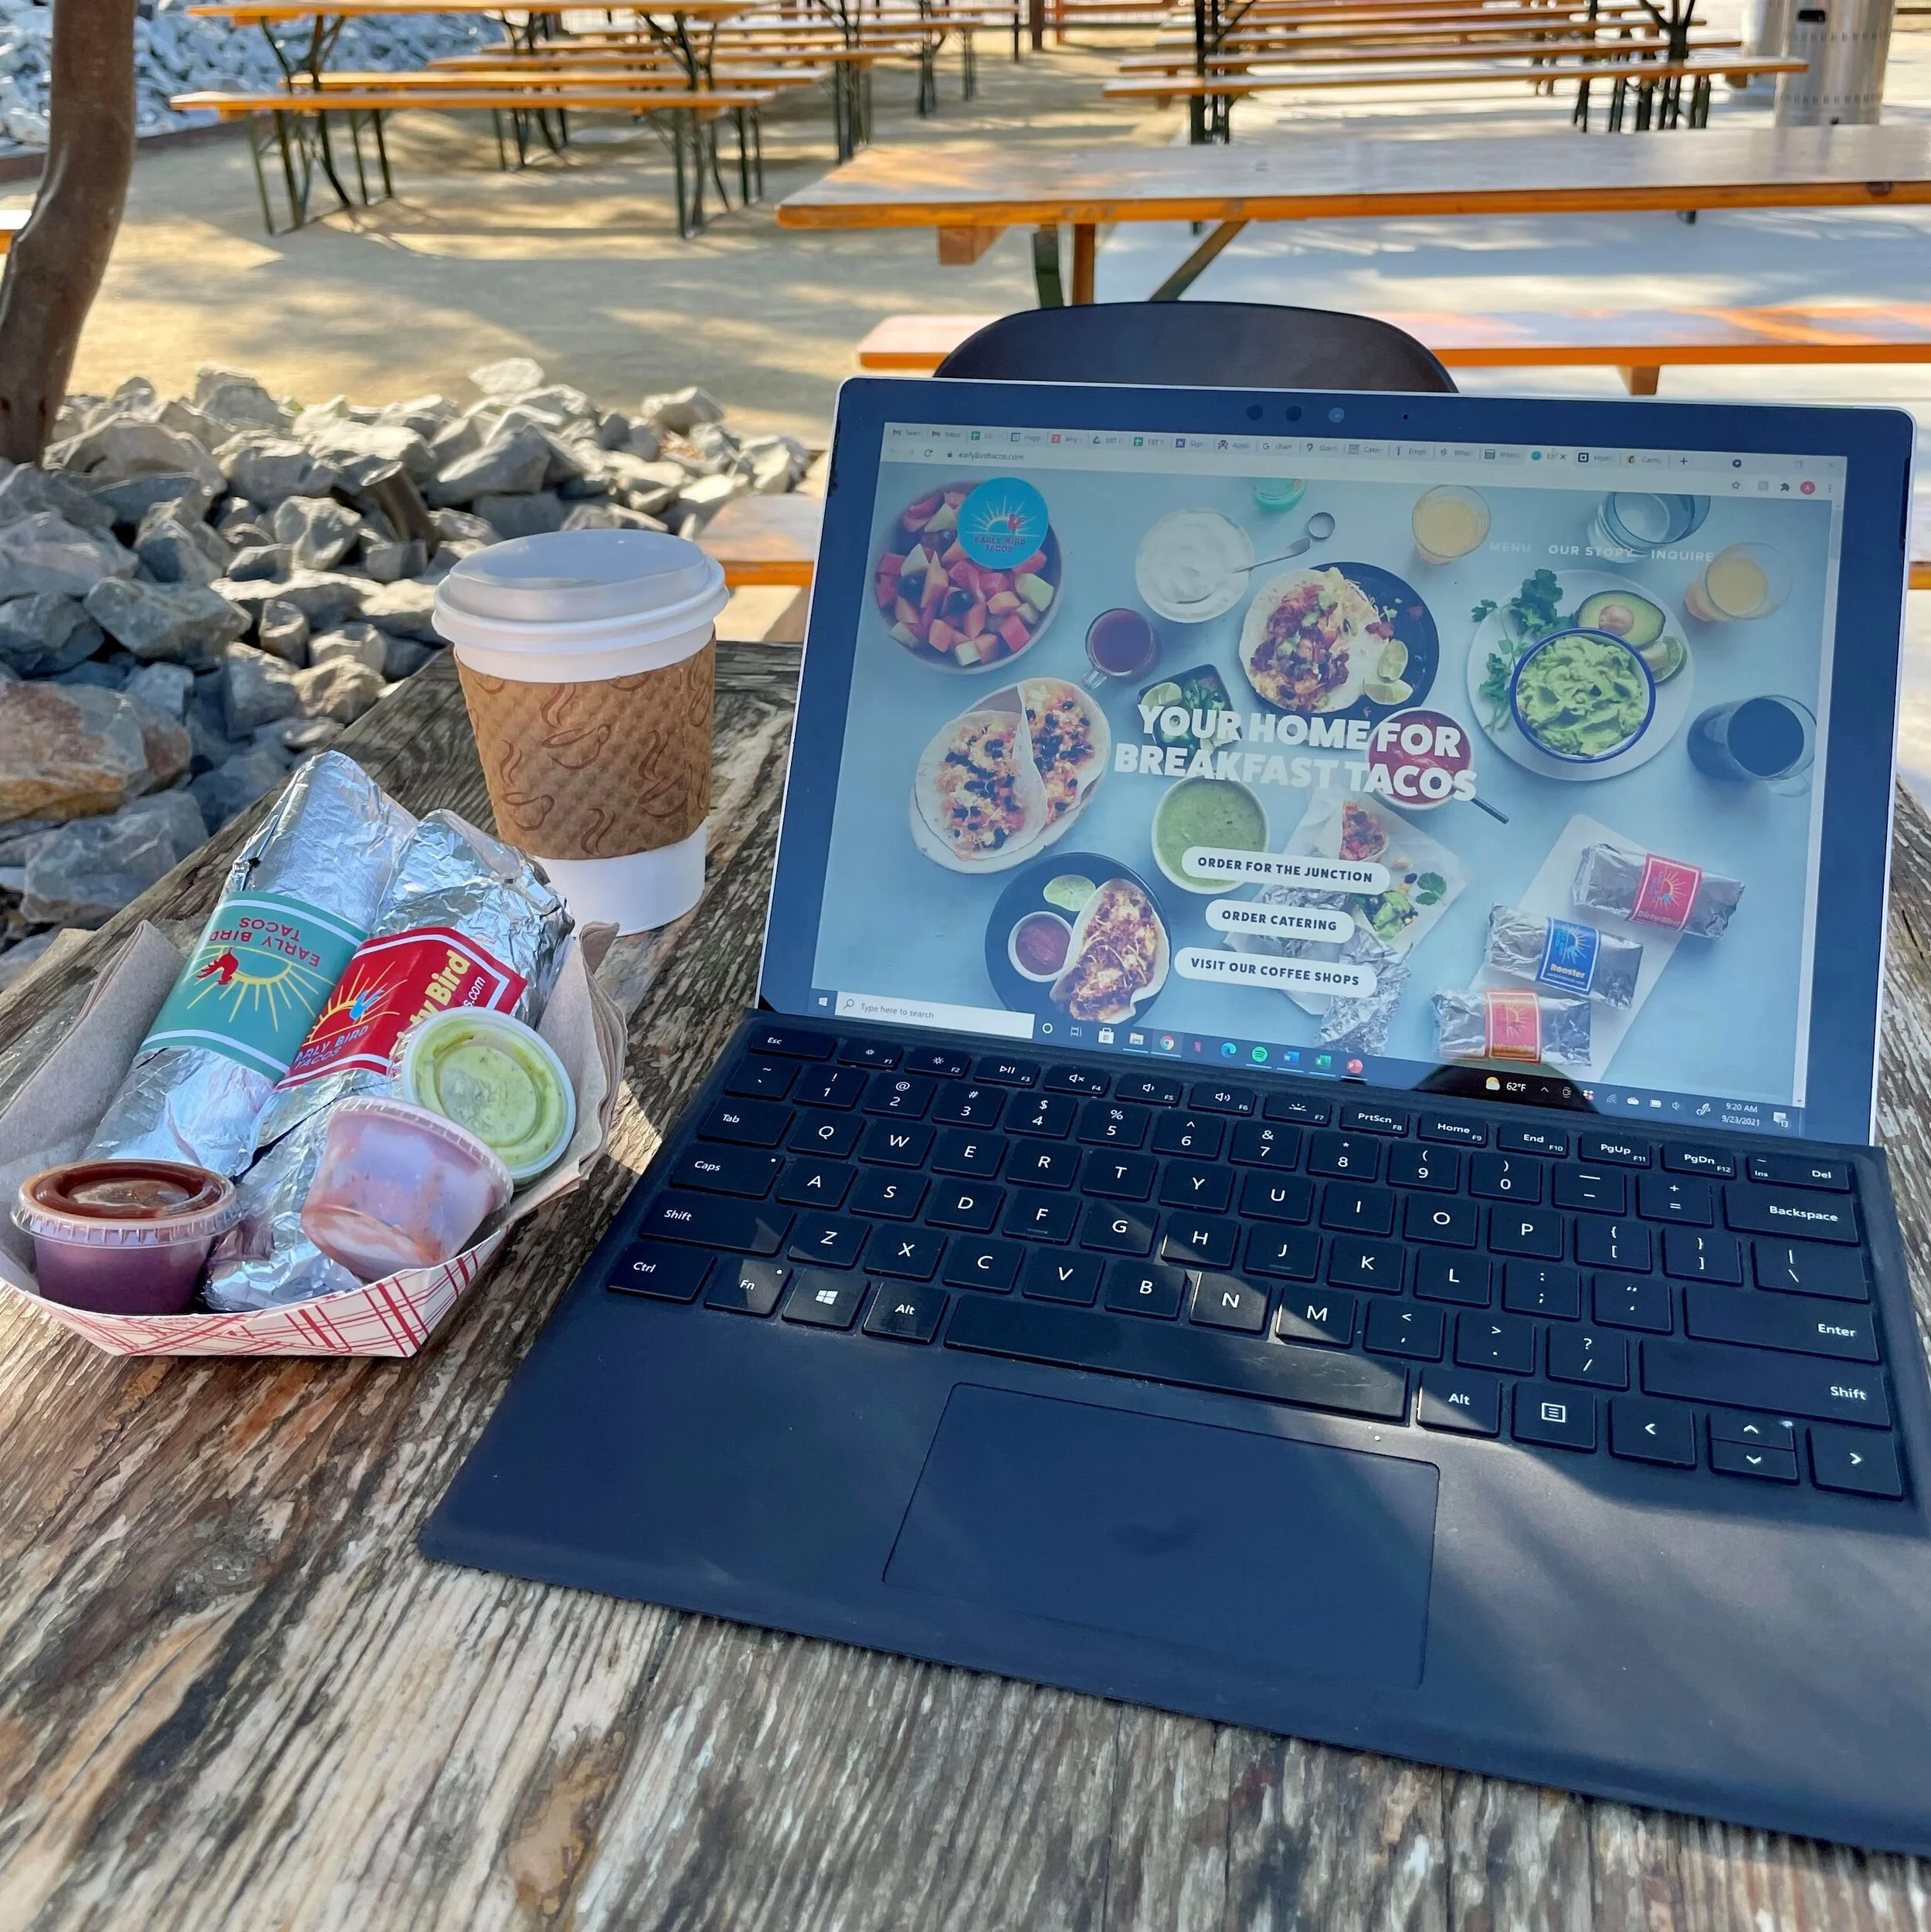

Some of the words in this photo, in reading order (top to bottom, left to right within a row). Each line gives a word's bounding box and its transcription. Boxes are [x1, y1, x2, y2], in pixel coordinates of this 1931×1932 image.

[958, 451, 1024, 462] earlybirdtacos.com
[974, 536, 1002, 545] EARLY
[985, 544, 1013, 552] TACOS
[1489, 542, 1531, 553] MENU
[1548, 545, 1580, 556] OUR
[1584, 546, 1634, 558] STORY
[1651, 549, 1714, 562] INQUIRE
[1138, 704, 1243, 742] YOUR
[1249, 713, 1370, 749] HOME
[1376, 722, 1461, 759] FOR
[1114, 742, 1339, 788] BREAKFAST
[1344, 761, 1477, 802] TACOS
[1197, 857, 1242, 871] ORDER
[1245, 861, 1272, 873] FOR
[1276, 864, 1301, 876] THE
[1304, 867, 1373, 883] JUNCTION
[1221, 909, 1267, 924] ORDER
[1270, 915, 1337, 932] CATERING
[209, 929, 253, 942] BIRD
[239, 917, 300, 942] TACOS
[261, 935, 321, 967] EARLY
[424, 949, 471, 1006] Bird
[1190, 957, 1226, 971] VISIT
[1229, 962, 1257, 975] OUR
[1260, 966, 1311, 981] COFFEE
[1314, 971, 1359, 986] SHOPS
[860, 1003, 878, 1014] Type
[880, 1004, 898, 1015] here
[899, 1007, 908, 1016] to
[909, 1009, 935, 1019] search
[334, 1025, 369, 1048] BIRD
[831, 1073, 838, 1082] !
[823, 1087, 831, 1097] 1
[895, 1081, 911, 1092] @
[1506, 1081, 1526, 1093] 62°F
[889, 1096, 901, 1107] 2
[1039, 1099, 1049, 1110] $
[1726, 1102, 1743, 1112] 9:20
[1743, 1105, 1758, 1113] AM
[960, 1105, 972, 1116] 3
[1110, 1109, 1124, 1120] %
[722, 1113, 740, 1123] Tab
[1032, 1115, 1043, 1126] 4
[1358, 1112, 1392, 1124] PrtScn
[1721, 1115, 1760, 1127] 9/23/2021
[1780, 1119, 1789, 1128] 13
[818, 1126, 835, 1140] Q
[1106, 1125, 1117, 1136] 5
[1261, 1129, 1274, 1140] &
[1437, 1122, 1471, 1134] Home
[890, 1134, 910, 1147] W
[1181, 1136, 1192, 1146] 6
[1523, 1133, 1544, 1143] End
[964, 1145, 977, 1158] E
[1260, 1146, 1271, 1157] 7
[1422, 1149, 1428, 1162] (
[1600, 1143, 1631, 1156] PgUp
[1037, 1156, 1051, 1169] R
[1337, 1156, 1349, 1167] 8
[1684, 1153, 1716, 1165] PgDn
[694, 1160, 721, 1172] Caps
[1115, 1166, 1128, 1179] T
[1503, 1160, 1509, 1172] )
[1418, 1167, 1429, 1179] 9
[1811, 1170, 1831, 1179] Del
[806, 1175, 821, 1188] A
[1192, 1177, 1206, 1190] Y
[1500, 1178, 1512, 1190] 0
[883, 1186, 897, 1198] S
[1271, 1188, 1286, 1202] U
[957, 1197, 974, 1210] D
[1356, 1200, 1362, 1213] I
[663, 1209, 692, 1221] Shift
[1036, 1208, 1049, 1221] F
[1433, 1211, 1451, 1225] O
[1769, 1205, 1838, 1222] Backspace
[1111, 1220, 1128, 1233] G
[1521, 1223, 1534, 1236] P
[1610, 1226, 1617, 1239] {
[820, 1231, 838, 1245] Z
[1192, 1231, 1209, 1245] H
[1697, 1237, 1704, 1250] }
[898, 1242, 915, 1258] X
[1278, 1244, 1288, 1258] J
[1611, 1245, 1617, 1258] [
[633, 1261, 657, 1273] Ctrl
[977, 1255, 993, 1269] C
[1361, 1255, 1375, 1271] K
[1699, 1256, 1705, 1270] ]
[1058, 1266, 1074, 1281] V
[1448, 1268, 1460, 1283] L
[739, 1279, 755, 1290] Fn
[1139, 1280, 1153, 1295] B
[1221, 1292, 1240, 1309] N
[894, 1304, 915, 1315] Alt
[1305, 1305, 1329, 1323] M
[1817, 1323, 1857, 1337] Enter
[1583, 1337, 1593, 1350] ?
[1583, 1359, 1593, 1372] /
[1448, 1393, 1470, 1405] Alt
[1830, 1386, 1866, 1401] Shift
